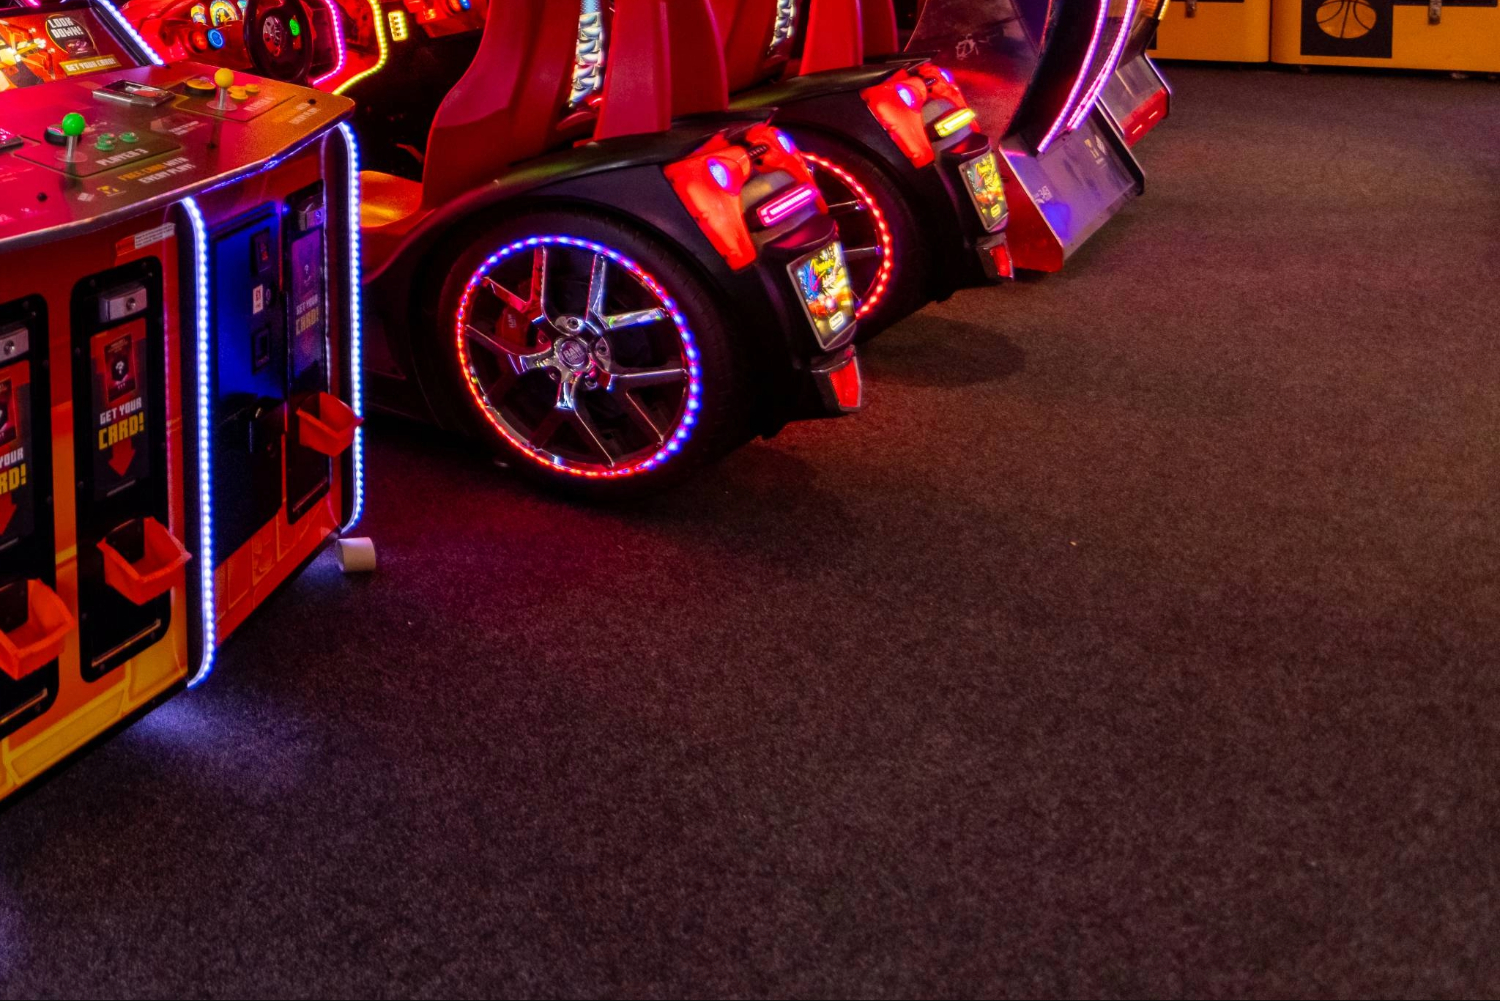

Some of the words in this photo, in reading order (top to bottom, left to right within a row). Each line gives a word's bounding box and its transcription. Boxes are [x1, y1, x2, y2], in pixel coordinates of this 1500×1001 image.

[48, 17, 74, 29] LOOK
[51, 25, 84, 39] DOWN!
[99, 407, 117, 426] GET
[119, 397, 142, 416] YOUR
[98, 411, 145, 450] CARD!
